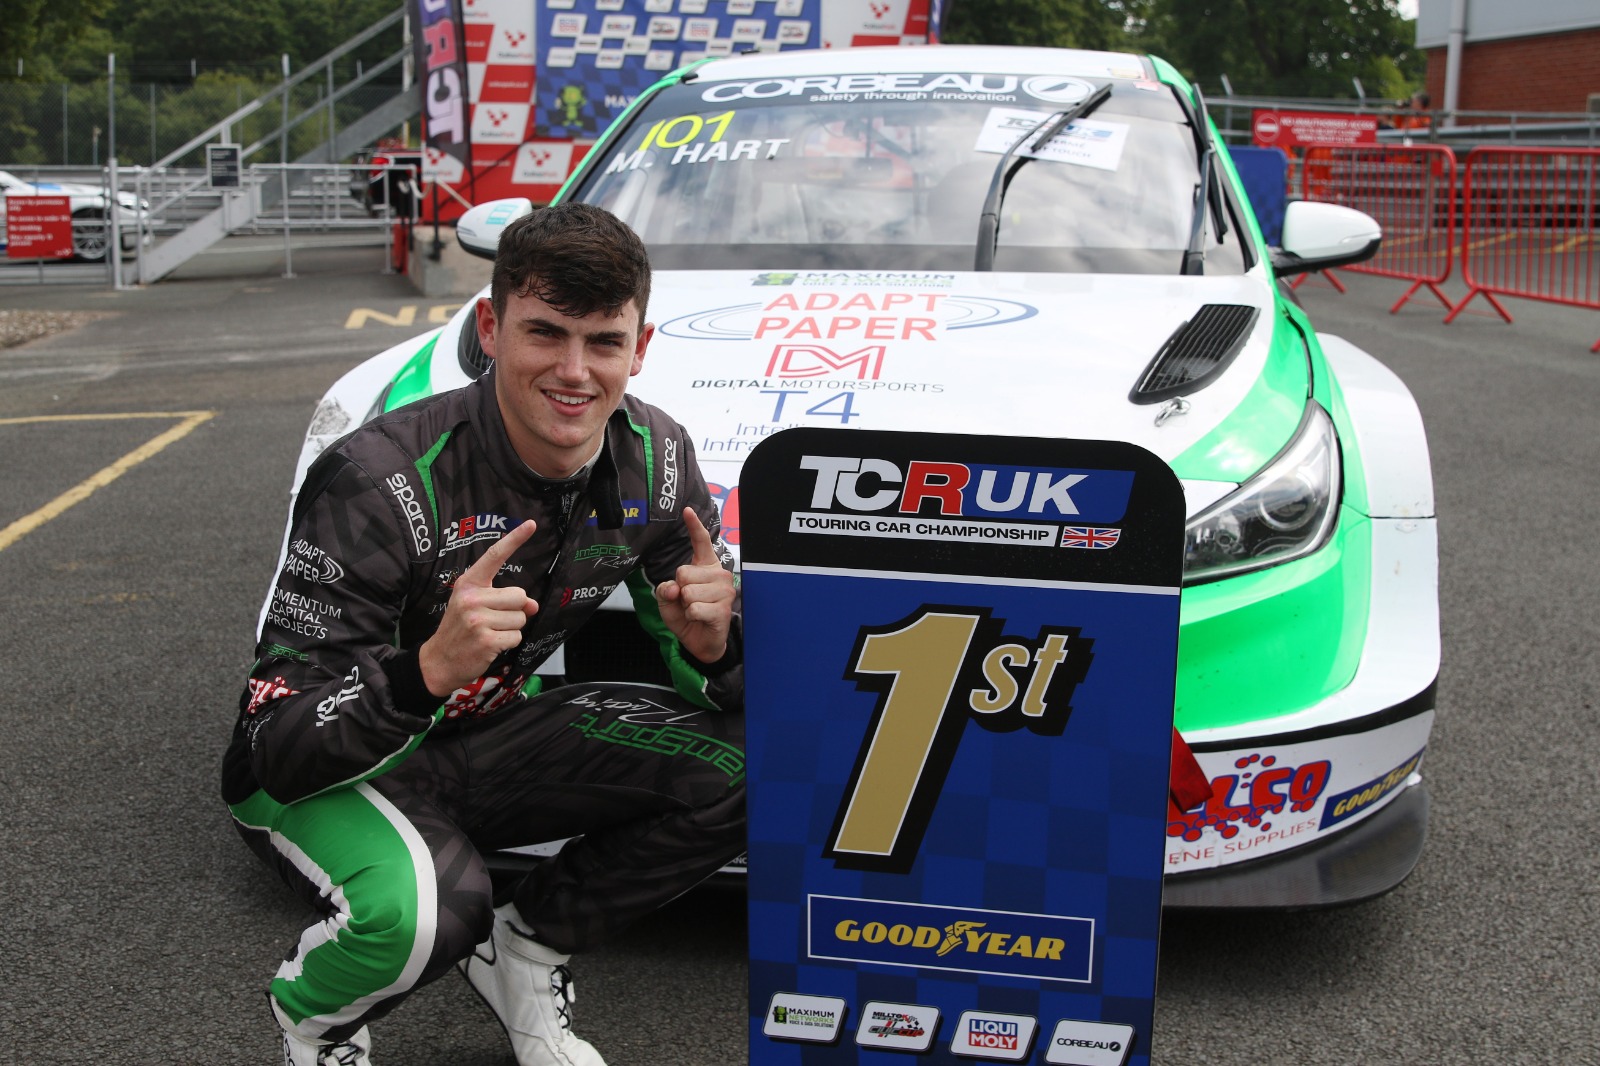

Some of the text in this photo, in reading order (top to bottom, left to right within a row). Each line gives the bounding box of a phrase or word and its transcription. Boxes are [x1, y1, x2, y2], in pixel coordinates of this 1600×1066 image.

[701, 73, 1019, 102] CORBEAU
[809, 90, 1017, 103] safety through innovation
[637, 110, 737, 152] 101
[604, 139, 791, 175] M. HART
[762, 292, 949, 312] ADAPT
[752, 316, 938, 341] PAPER
[691, 378, 945, 394] DIGITAL MOTORSPORTS
[759, 390, 860, 425] T4
[659, 437, 678, 513] sparco
[386, 473, 432, 556] sparco
[796, 516, 1050, 542] TOURING CAR CHAMPIONSHIP
[295, 538, 326, 565] ADAPT
[283, 553, 322, 586] PAPER
[267, 611, 328, 640] PROJECTS
[272, 600, 322, 625] CAPITAL
[831, 610, 1070, 857] 1st
[1224, 818, 1317, 855] SUPPLIES
[788, 1007, 835, 1019] MAXIMUM
[788, 1014, 835, 1024] NETWORKS
[970, 1019, 1017, 1036] LIQUI
[970, 1033, 1018, 1049] MOLY
[1056, 1037, 1110, 1051] CORBEAU
